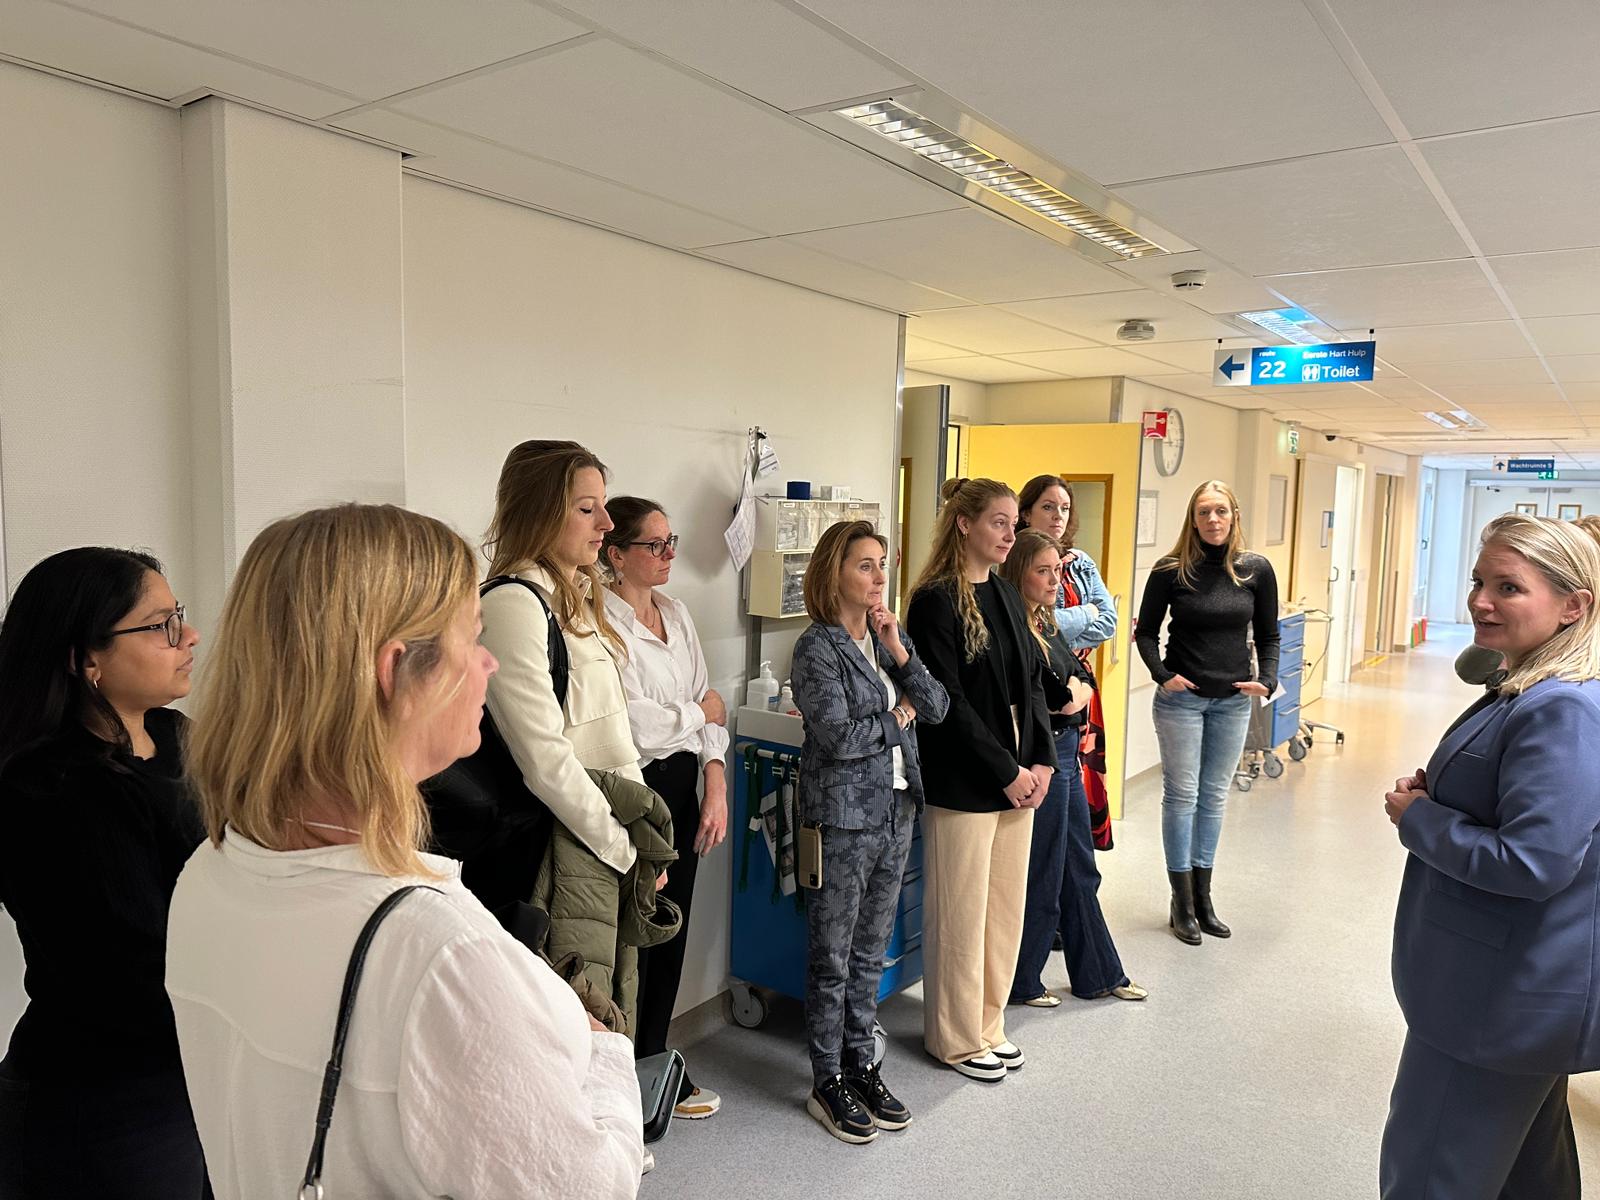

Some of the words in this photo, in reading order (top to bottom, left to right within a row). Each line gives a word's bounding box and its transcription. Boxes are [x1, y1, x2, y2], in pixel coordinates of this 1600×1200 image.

[1329, 350, 1346, 358] Hart
[1347, 349, 1366, 357] Hulp
[1259, 360, 1286, 378] 22
[1321, 365, 1360, 378] Toilet
